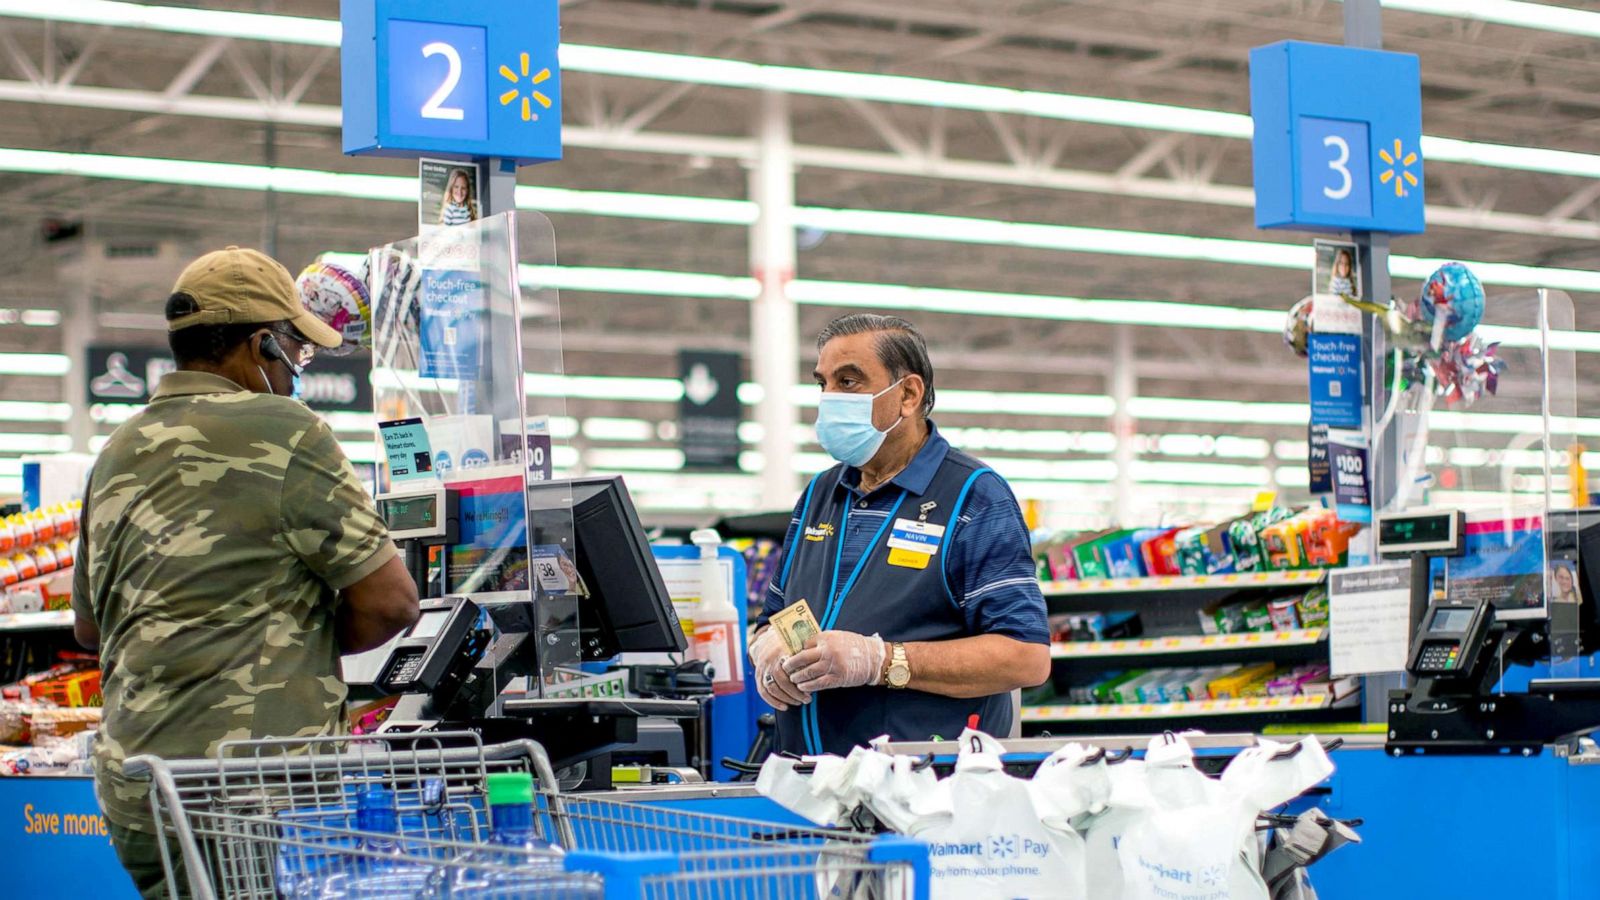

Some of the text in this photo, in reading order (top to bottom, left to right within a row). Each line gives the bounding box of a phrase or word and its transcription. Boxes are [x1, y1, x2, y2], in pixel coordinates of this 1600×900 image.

[420, 42, 464, 120] 2
[1323, 135, 1352, 200] 3
[426, 277, 476, 290] Touch-free
[426, 291, 468, 304] checkout
[1312, 339, 1356, 352] Touch-free
[1312, 351, 1350, 363] checkout
[1336, 455, 1363, 473] $100
[1338, 471, 1364, 486] Bonus
[904, 532, 928, 542] NAVIN
[24, 803, 59, 834] Save
[928, 839, 1049, 857] Walmart Pay
